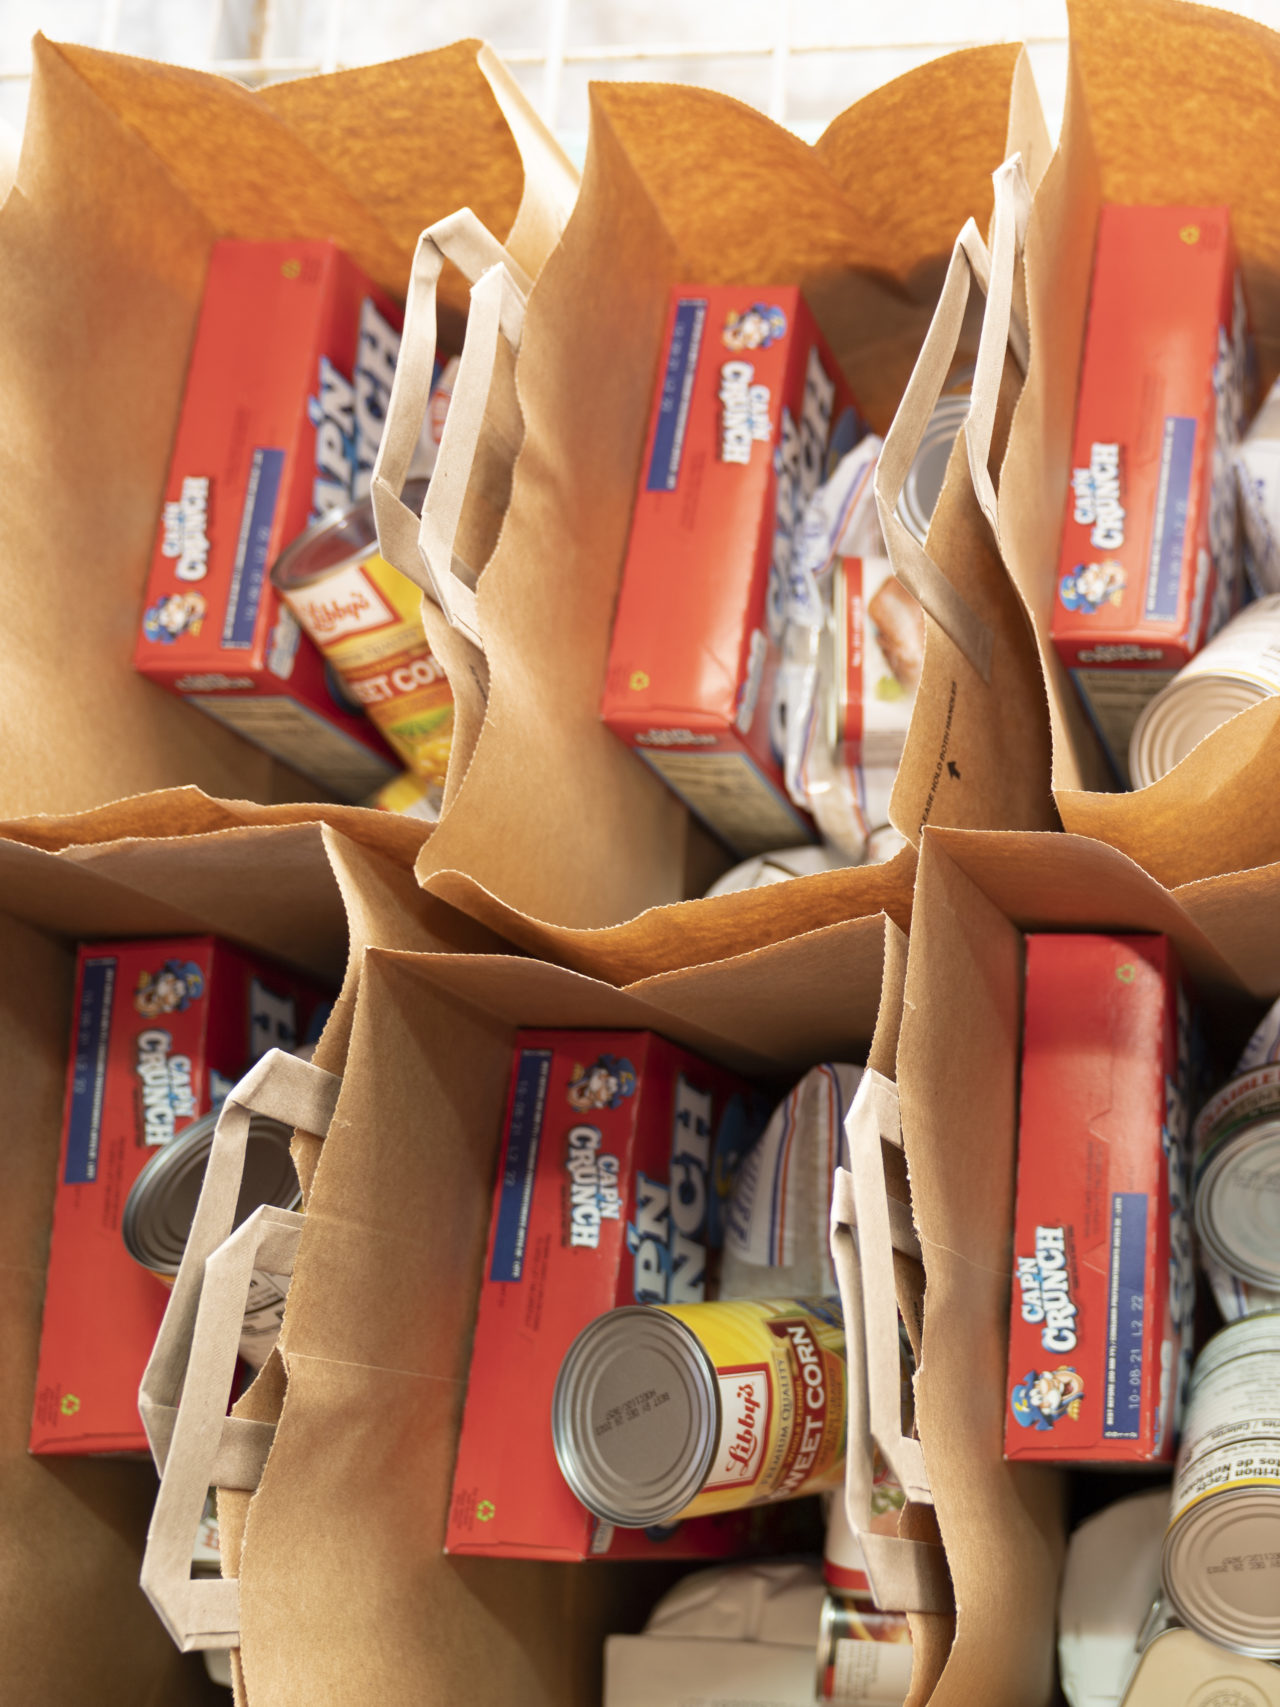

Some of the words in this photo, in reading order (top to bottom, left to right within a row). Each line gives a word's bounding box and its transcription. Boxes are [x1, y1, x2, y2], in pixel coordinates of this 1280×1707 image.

[1091, 441, 1127, 550] CRUNCH
[136, 1029, 176, 1146] CRUNCH
[566, 1123, 601, 1250] CRUNCH
[627, 1170, 674, 1302] P'N
[668, 1072, 712, 1302] NCH
[1016, 1257, 1044, 1323] CAP'N
[1036, 1227, 1078, 1352] CRUNCH
[1130, 1320, 1143, 1336] L2
[1131, 1295, 1144, 1311] 22
[788, 1326, 823, 1408] CORN
[726, 1384, 761, 1476] Libby's
[1236, 1458, 1254, 1470] de
